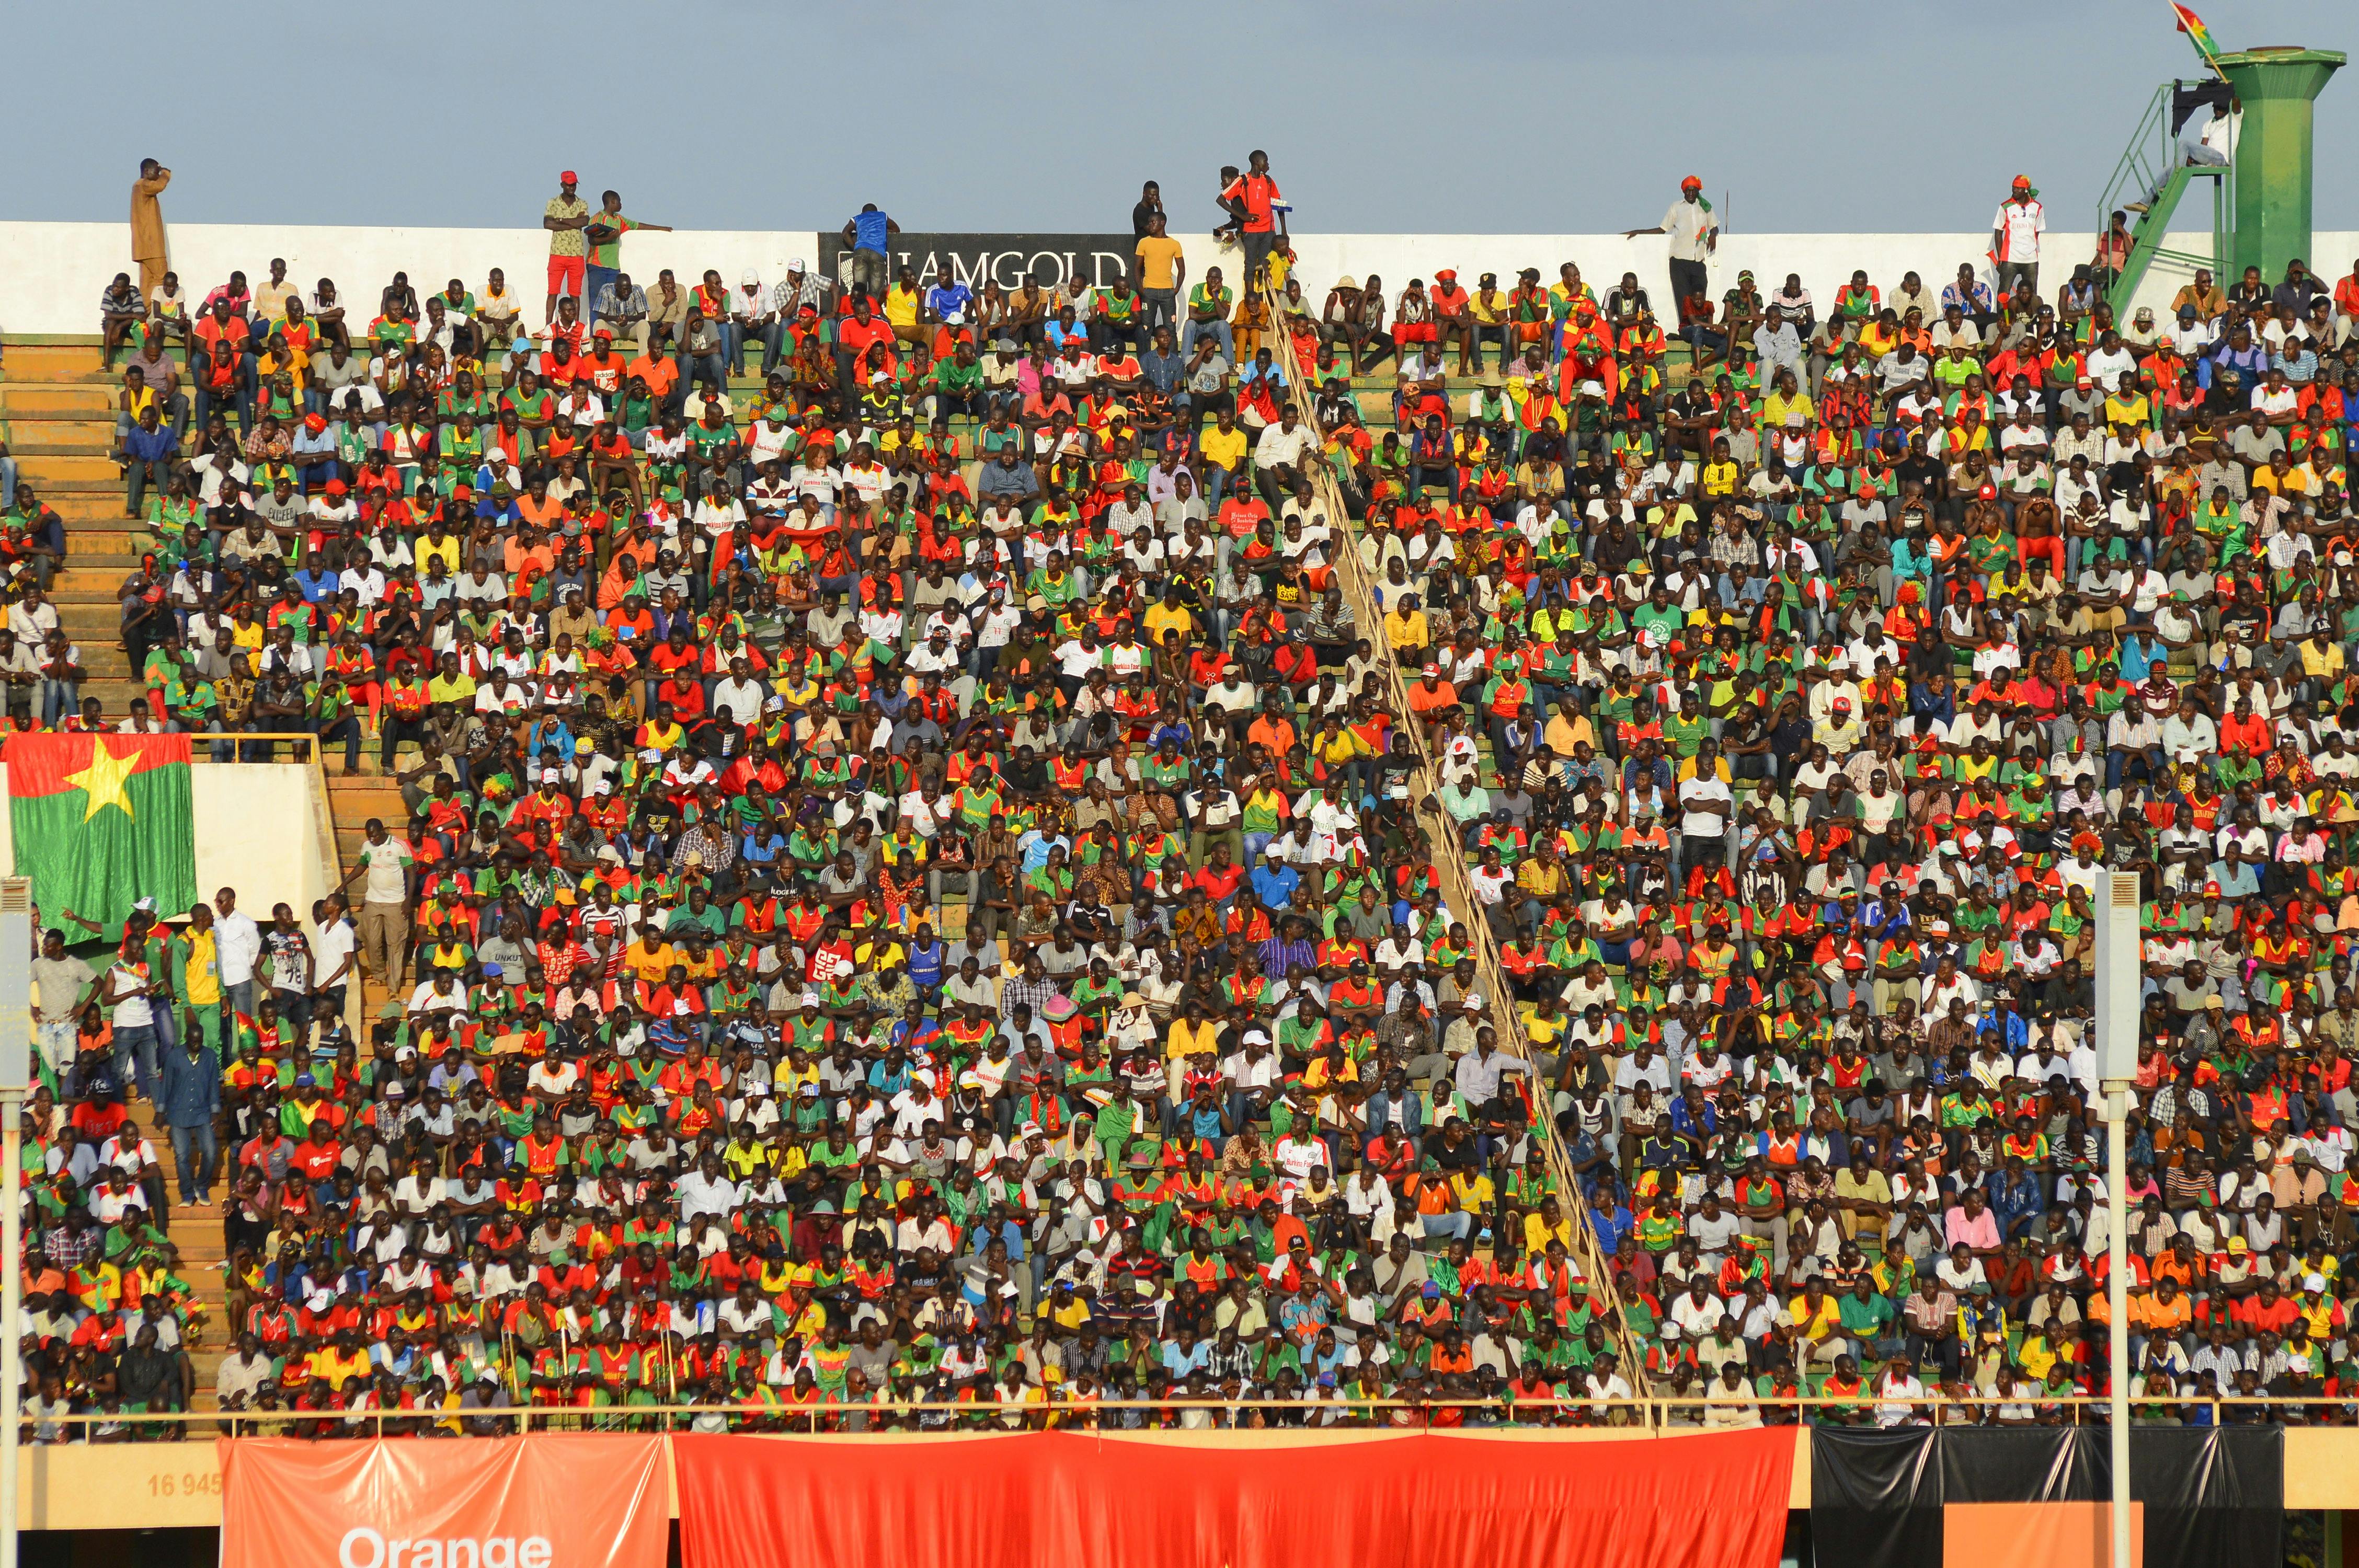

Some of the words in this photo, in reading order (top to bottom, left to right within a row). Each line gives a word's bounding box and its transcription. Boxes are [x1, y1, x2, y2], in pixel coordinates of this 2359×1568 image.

[897, 251, 1127, 291] IAMGOLD
[757, 443, 774, 453] Burkina
[269, 507, 295, 522] EXCEED
[571, 583, 582, 591] TEAM
[993, 627, 1001, 635] 11
[2028, 813, 2035, 822] 15
[1490, 889, 1494, 897] 7
[495, 954, 523, 963] UNKUT
[976, 1072, 992, 1081] Burkina
[1286, 1158, 1303, 1167] Burkina
[148, 1474, 175, 1497] 16
[182, 1473, 222, 1495] 945
[339, 1527, 553, 1568] Orange
